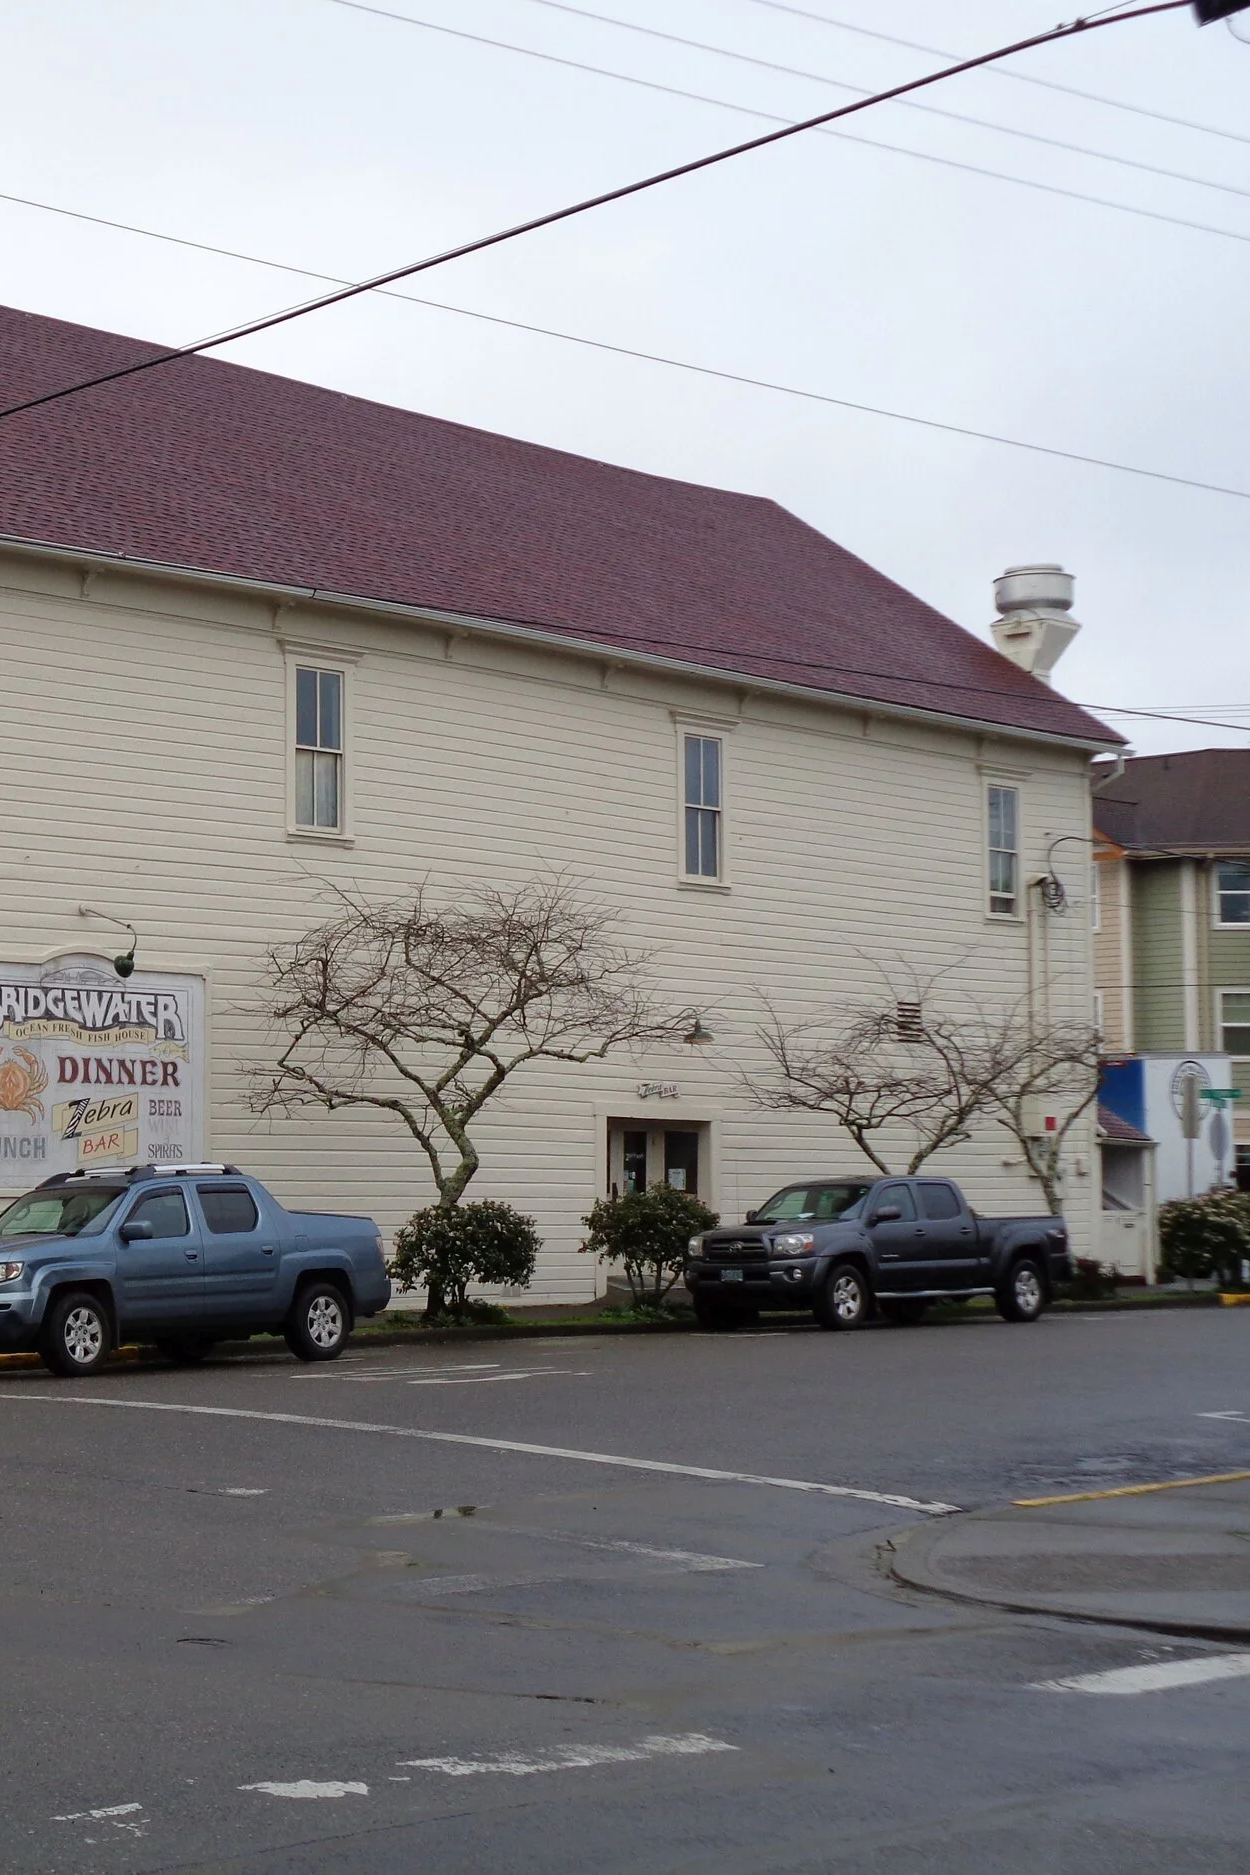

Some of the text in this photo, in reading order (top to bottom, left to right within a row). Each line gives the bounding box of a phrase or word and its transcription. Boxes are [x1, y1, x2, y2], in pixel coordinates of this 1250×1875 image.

[16, 1021, 146, 1042] OCEAN FRESH FISH HOUSE
[57, 1056, 181, 1087] DINNER
[62, 1097, 134, 1140] Zebra
[148, 1099, 183, 1117] BEER
[82, 1133, 121, 1155] BAR
[147, 1143, 183, 1159] SPIRITS
